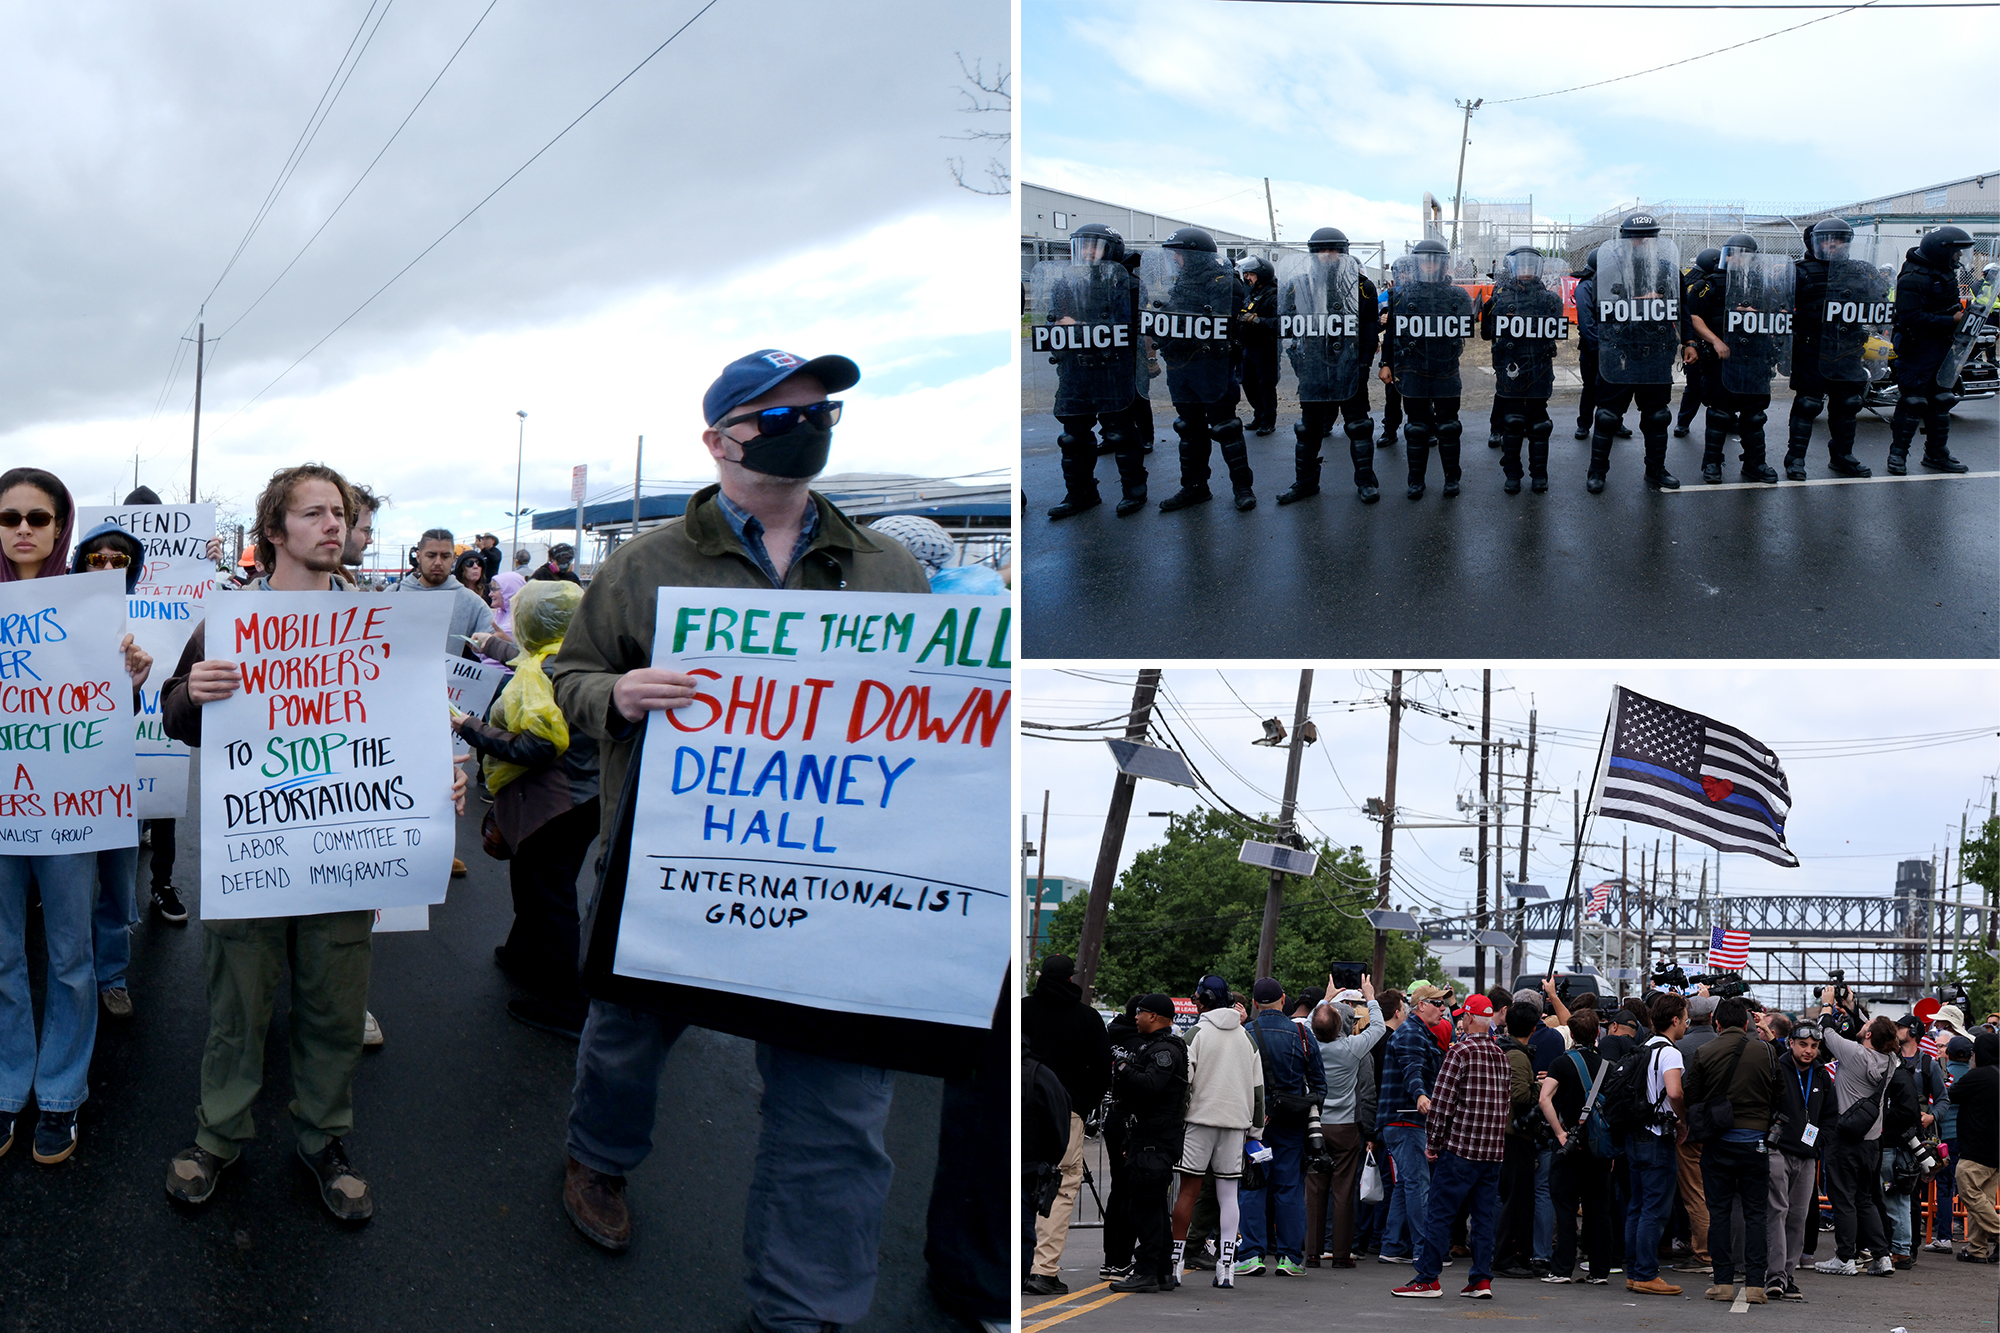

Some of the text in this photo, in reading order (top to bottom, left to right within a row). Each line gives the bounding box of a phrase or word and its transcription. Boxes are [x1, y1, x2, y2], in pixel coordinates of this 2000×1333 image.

[1632, 216, 1653, 225] 11297
[1139, 311, 1229, 340] POLICE
[1279, 314, 1357, 338] POLICE
[1395, 315, 1472, 338] POLICE
[1496, 316, 1569, 339] POLICE
[1600, 299, 1678, 323] POLICE
[1728, 311, 1793, 334] POLICE
[1826, 301, 1894, 325] POLICE
[1034, 324, 1130, 350] POLICE
[140, 537, 208, 560] GRANTS
[127, 600, 190, 620] UDENTS
[0, 607, 67, 647] RATS
[235, 606, 392, 654] MOBILIZE
[672, 606, 1012, 668] FREE THEM ALL
[240, 643, 391, 695] WORKERS'
[453, 662, 483, 681] HALL
[58, 681, 116, 714] COPS
[269, 689, 367, 731] POWER
[665, 667, 1011, 748] SHUT DOWN
[63, 717, 109, 754] ICE
[224, 732, 395, 778] TO STOP THE
[14, 763, 34, 791] A
[671, 745, 916, 809] DELANEY
[54, 783, 133, 818] PARTY!
[223, 775, 415, 829] DEPORTATIONS
[51, 826, 93, 845] GROUP
[227, 827, 421, 863] LABOR COMMITTEE TO
[703, 804, 837, 853] HALL
[221, 858, 409, 895] DEFEND IMMIGRANTS
[659, 866, 974, 916] INTERNATIONALIST
[705, 902, 809, 929] GROUP
